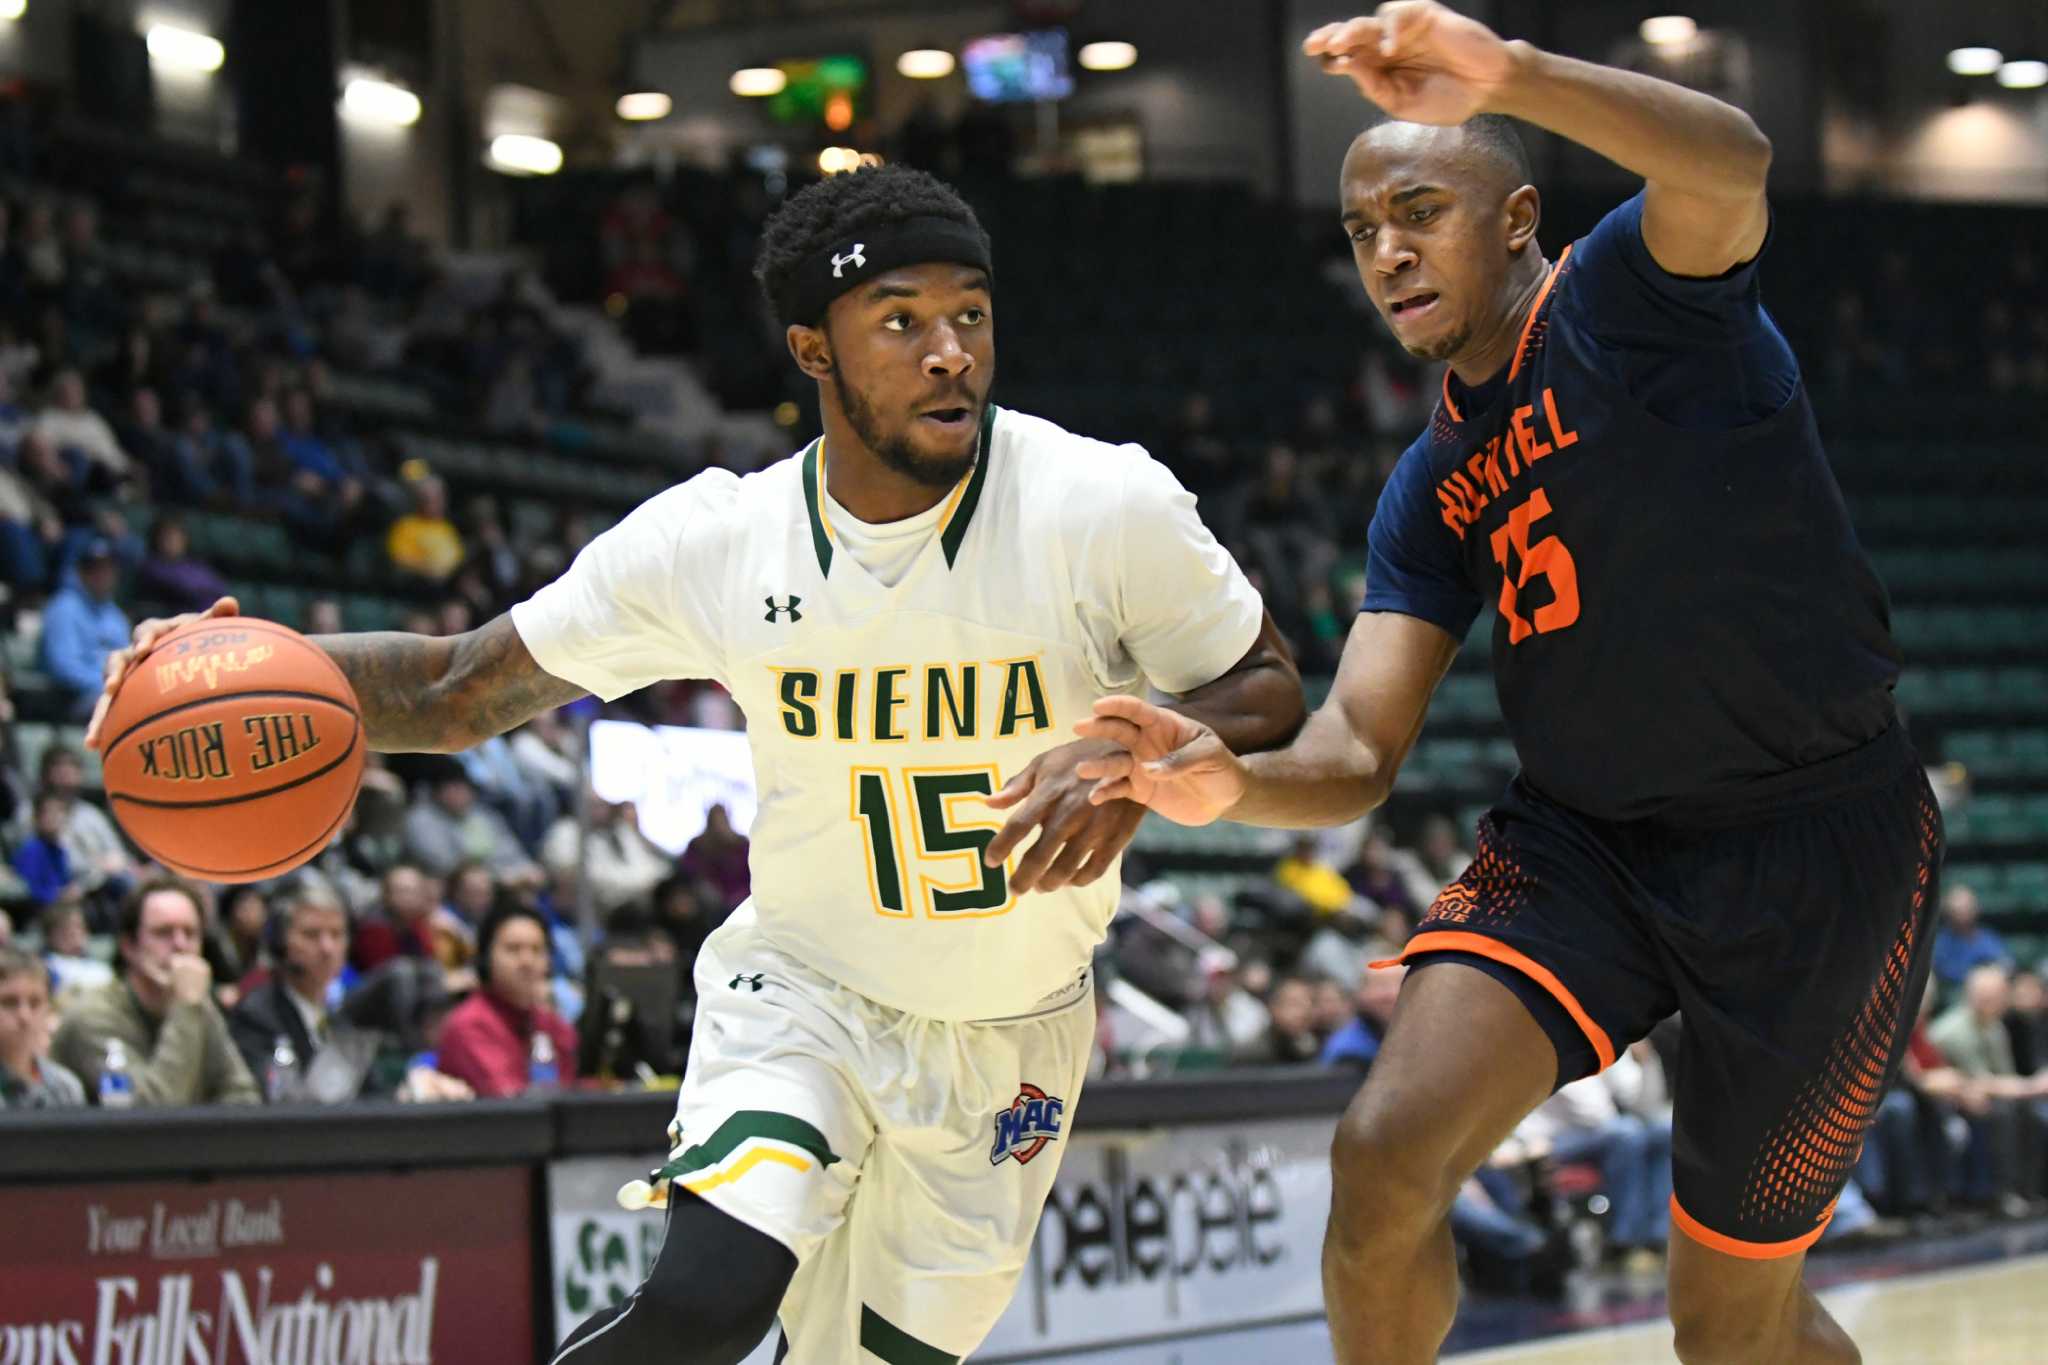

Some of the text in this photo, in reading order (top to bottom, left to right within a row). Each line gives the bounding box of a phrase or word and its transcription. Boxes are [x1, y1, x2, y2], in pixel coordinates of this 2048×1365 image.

[1490, 487, 1580, 645] 15
[137, 713, 321, 781] THE ROCK
[768, 653, 1055, 743] SIENA
[850, 763, 1016, 919] 15
[88, 1198, 284, 1256] Your Local Bank
[93, 1276, 212, 1365] Falls
[214, 1255, 439, 1365] National
